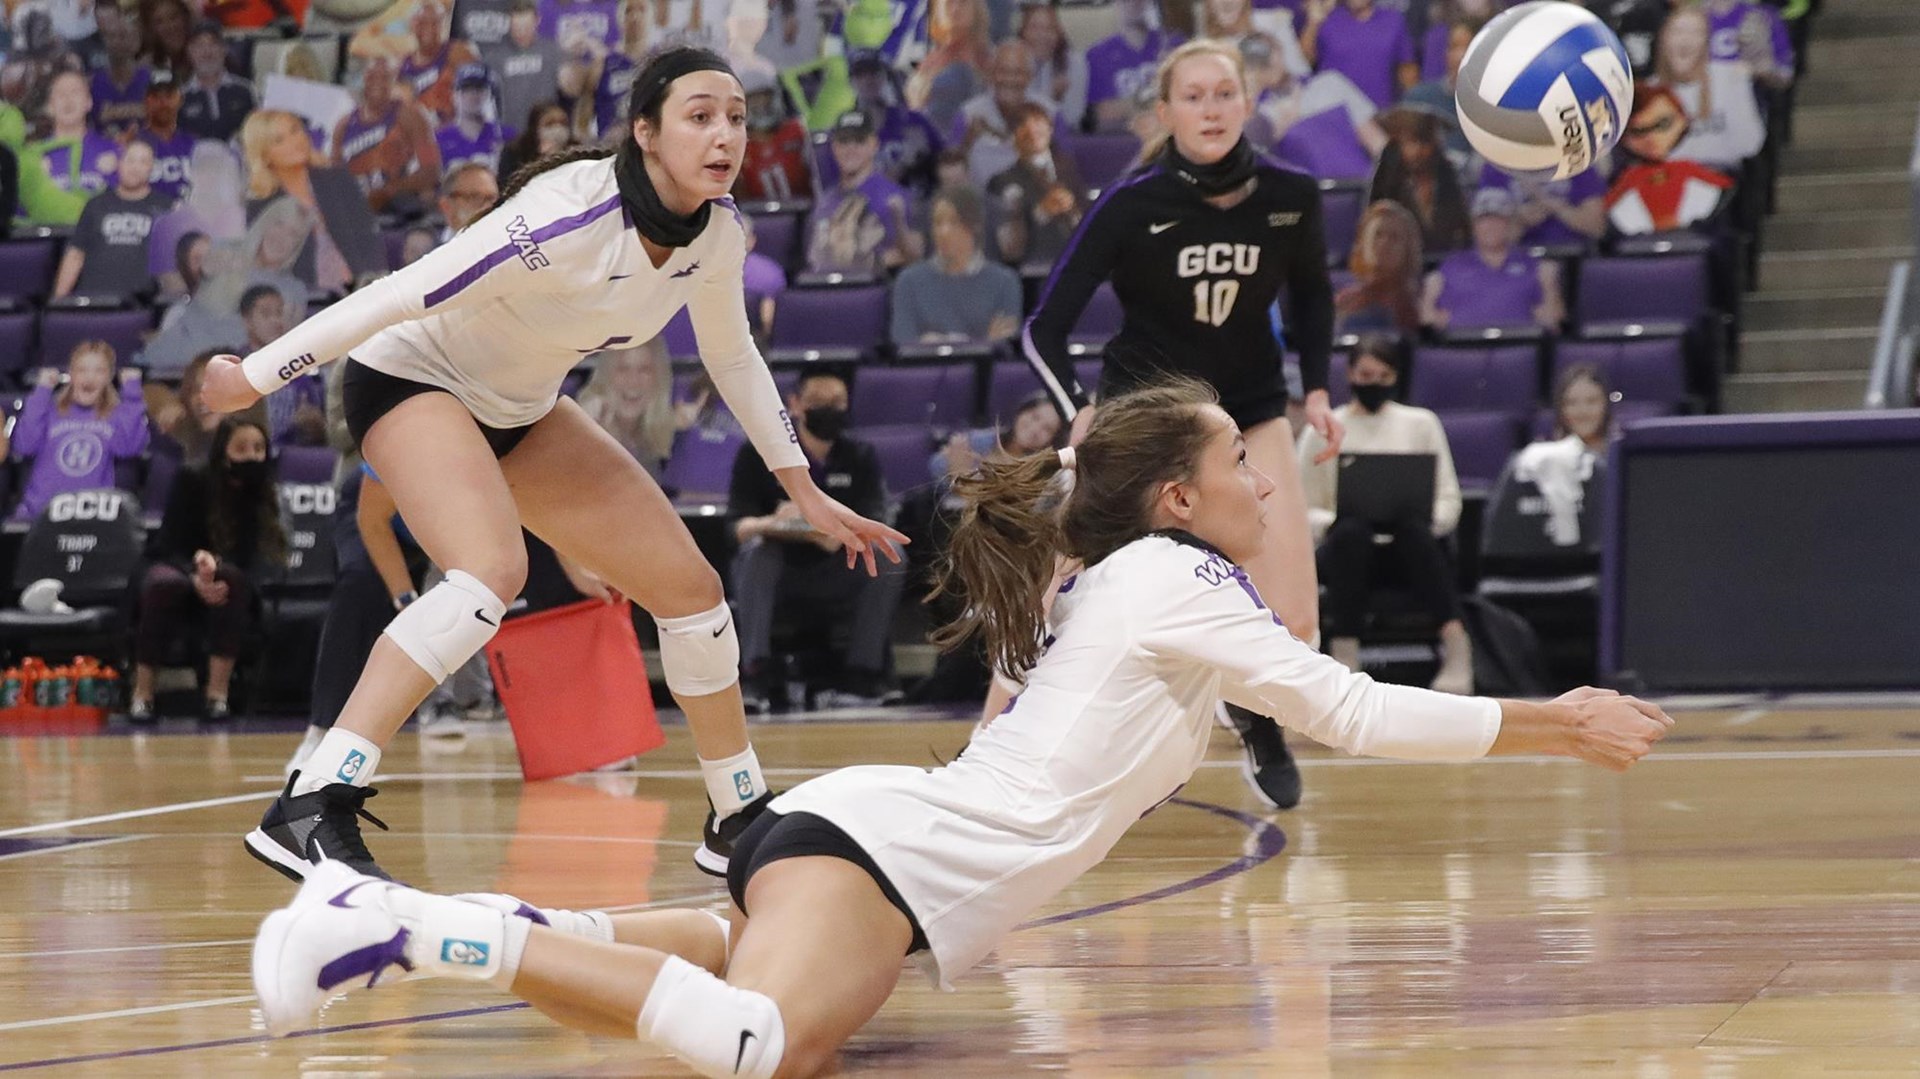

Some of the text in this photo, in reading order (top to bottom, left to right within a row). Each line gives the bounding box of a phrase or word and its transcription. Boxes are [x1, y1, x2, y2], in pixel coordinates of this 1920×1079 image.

[505, 214, 550, 271] WAC
[1177, 242, 1261, 278] GCU
[1193, 279, 1240, 328] 10
[278, 353, 316, 381] GCU
[779, 409, 798, 444] GCU
[49, 491, 122, 523] GCU
[57, 533, 98, 553] TRAPP
